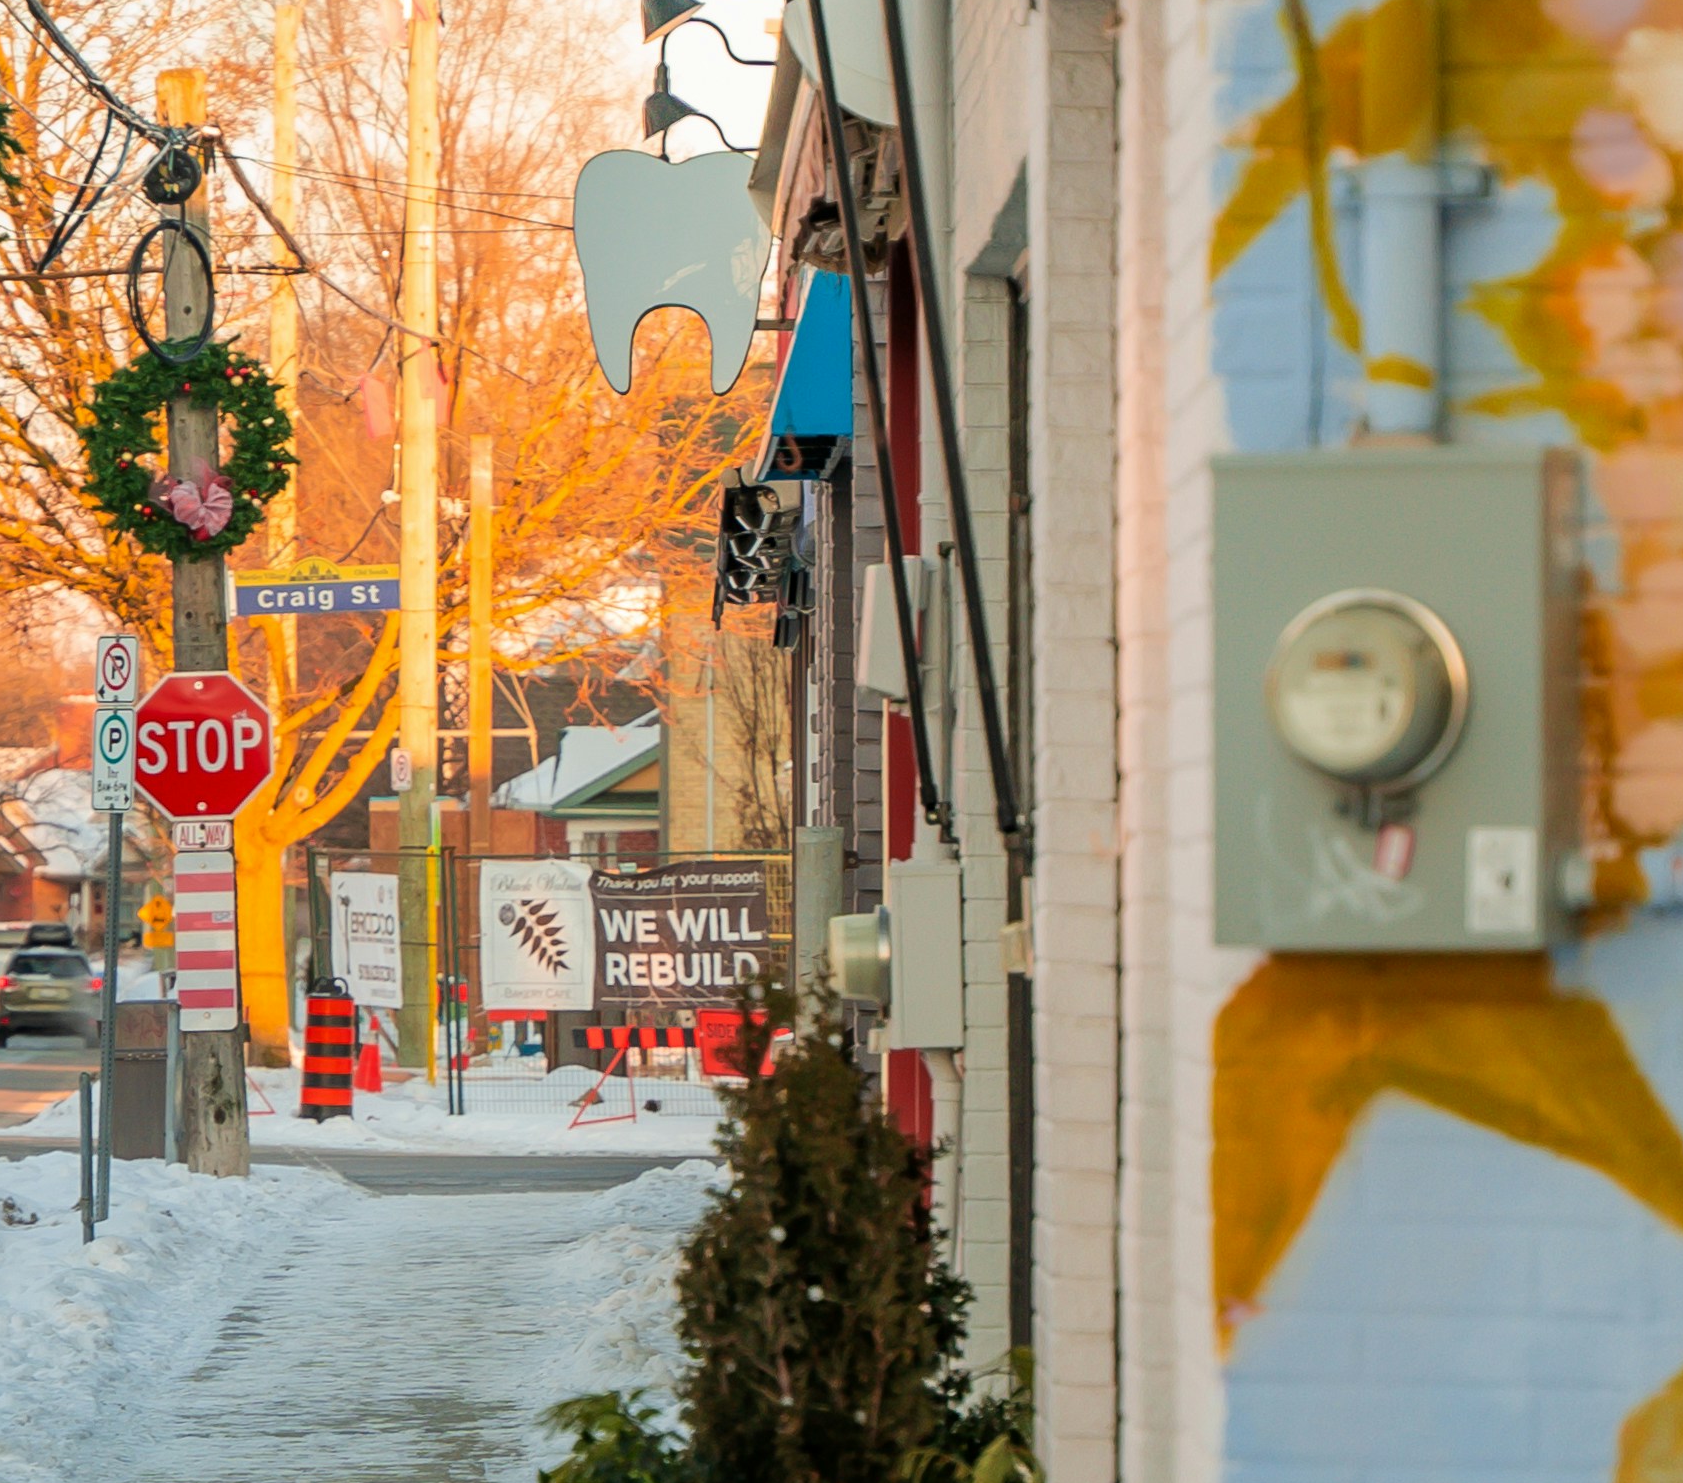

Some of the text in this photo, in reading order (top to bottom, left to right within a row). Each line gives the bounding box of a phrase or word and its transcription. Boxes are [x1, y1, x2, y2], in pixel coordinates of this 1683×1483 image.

[257, 584, 381, 610] Craig St
[138, 719, 263, 775] STOP
[179, 825, 228, 846] ALL-WAY
[596, 876, 635, 889] Thank
[636, 879, 659, 890] you
[660, 874, 677, 887] for
[680, 873, 711, 887] your
[599, 907, 763, 943] WE WILL
[605, 951, 760, 987] REBUILD
